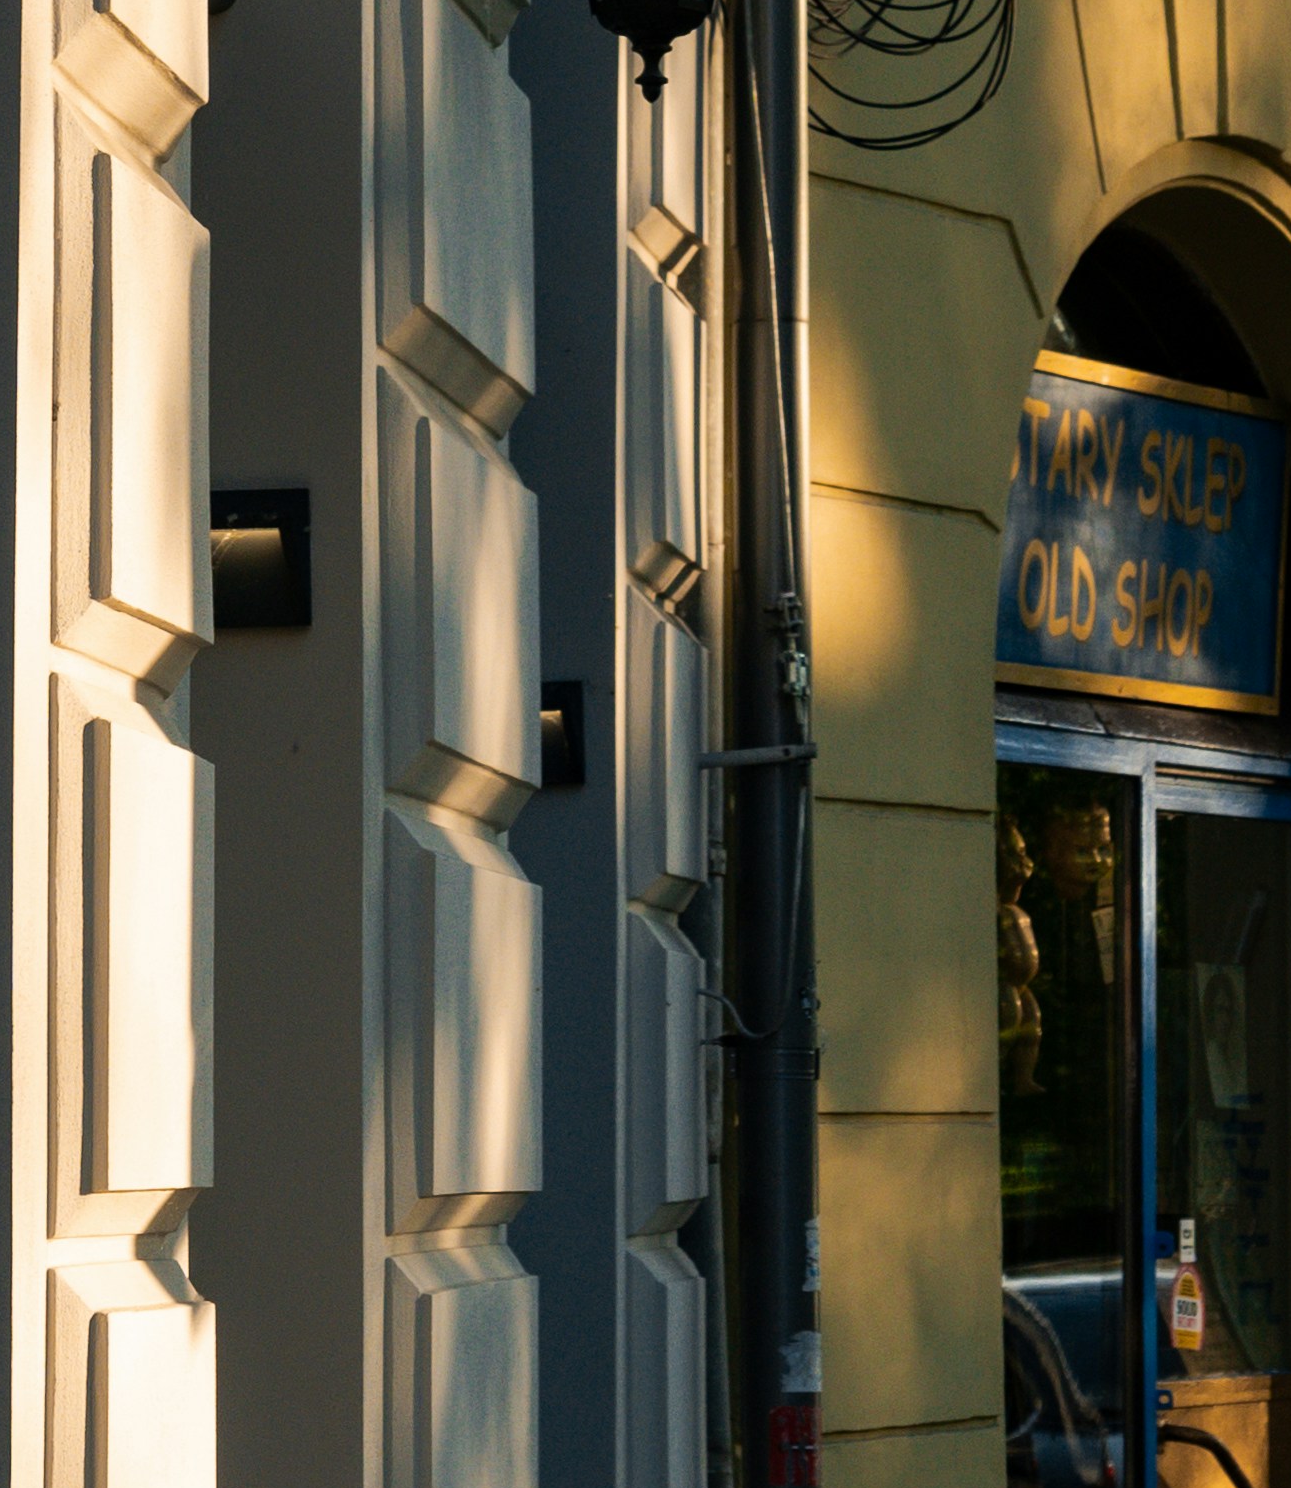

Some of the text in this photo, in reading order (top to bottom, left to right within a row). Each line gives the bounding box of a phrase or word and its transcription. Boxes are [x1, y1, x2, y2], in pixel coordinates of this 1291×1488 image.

[1010, 397, 1247, 534] TARY SKLEP
[1018, 537, 1214, 658] OLD SHOP
